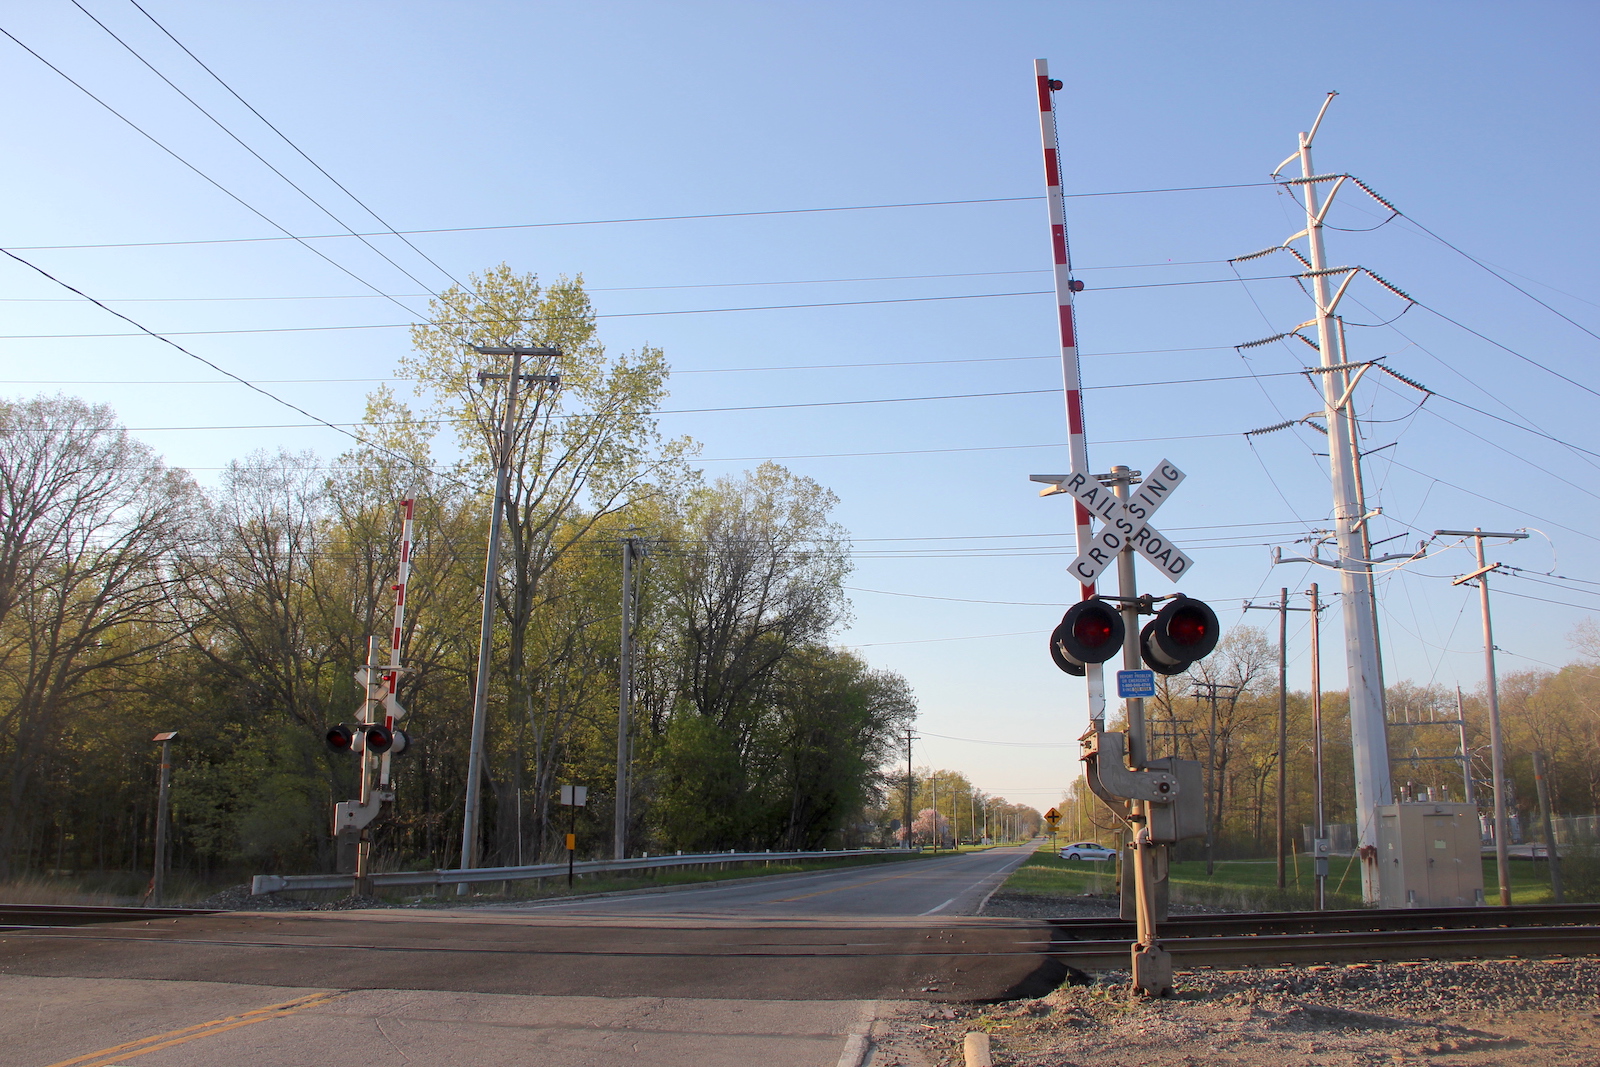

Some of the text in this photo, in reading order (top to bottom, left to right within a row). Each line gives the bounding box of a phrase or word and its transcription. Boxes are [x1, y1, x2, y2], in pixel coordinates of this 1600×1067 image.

[1067, 473, 1186, 575] RAIL ROAD
[1077, 466, 1179, 577] CROSSING
